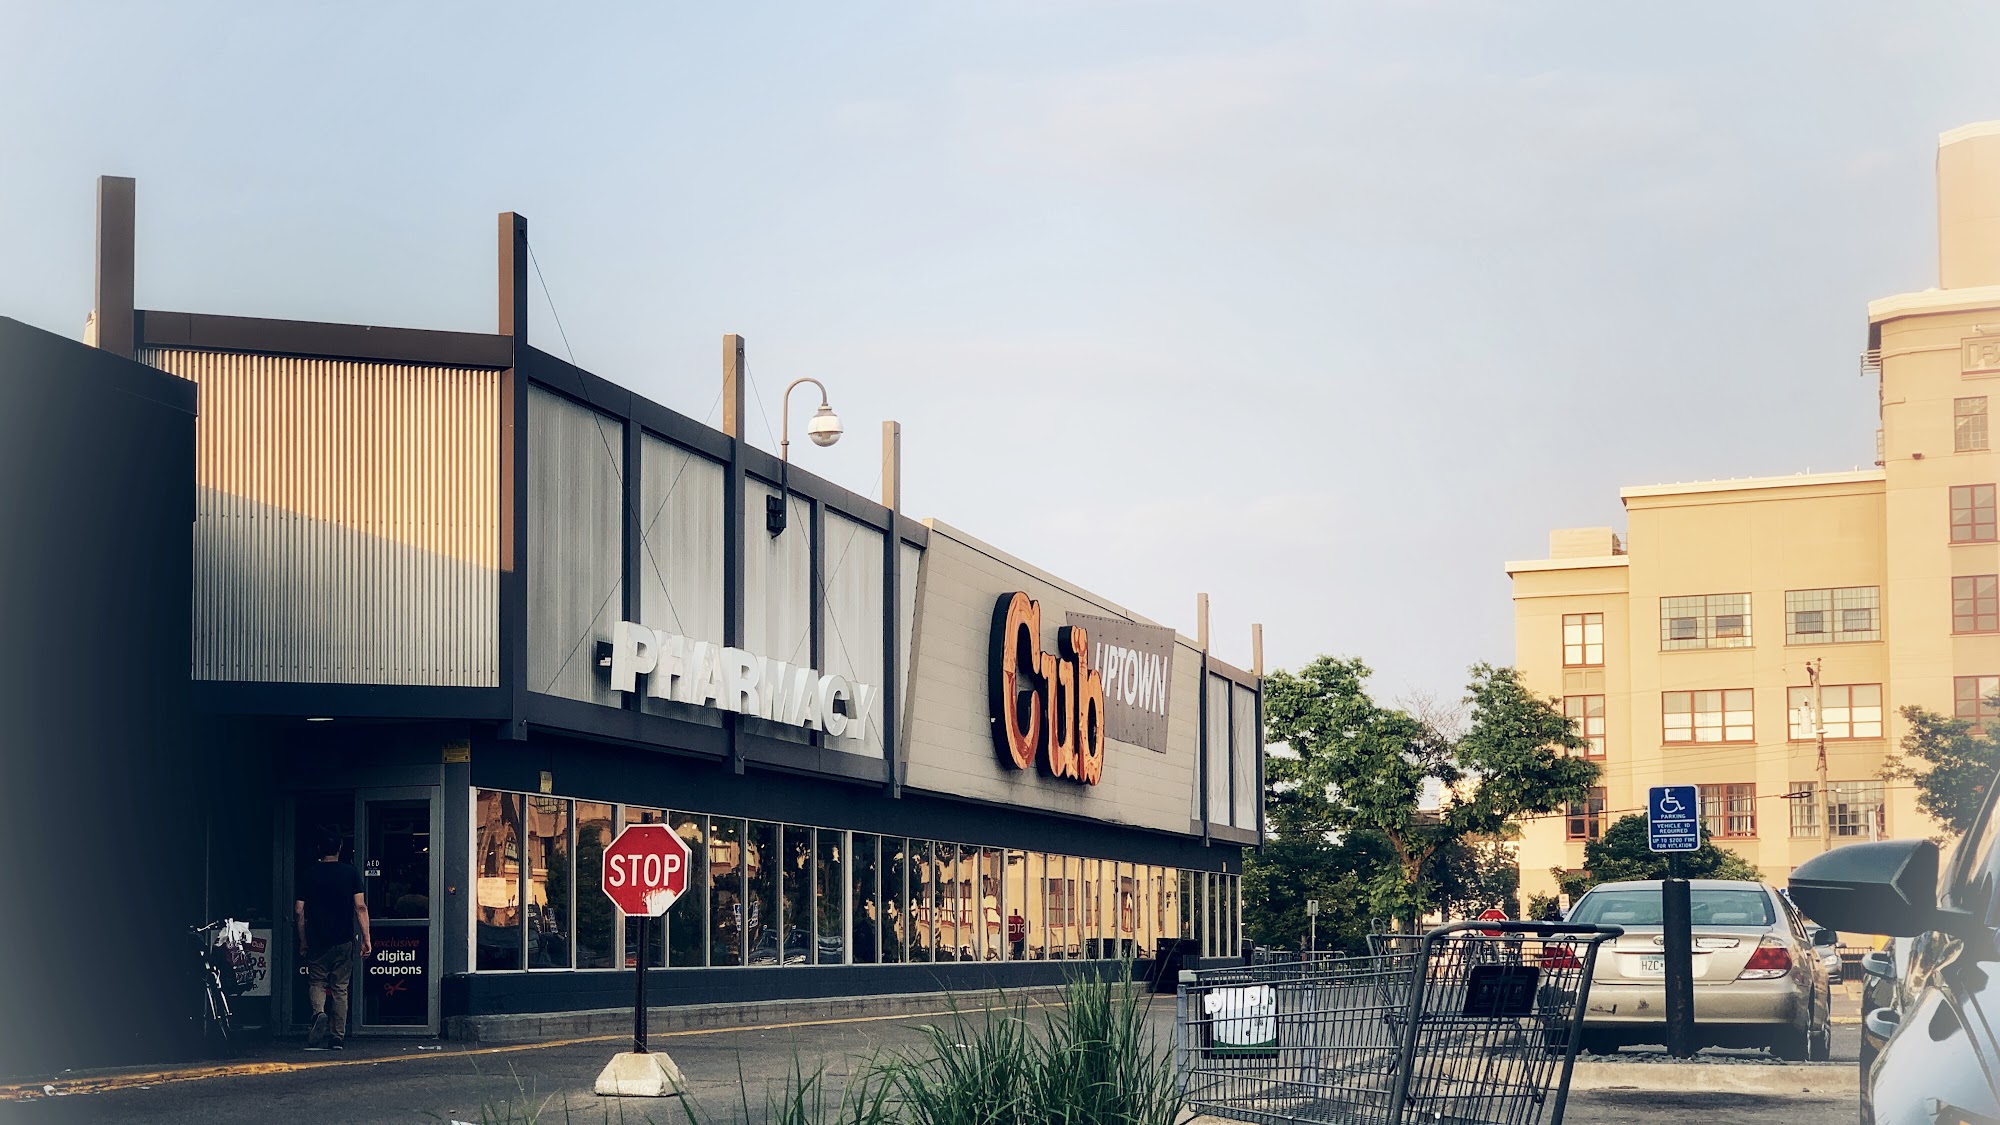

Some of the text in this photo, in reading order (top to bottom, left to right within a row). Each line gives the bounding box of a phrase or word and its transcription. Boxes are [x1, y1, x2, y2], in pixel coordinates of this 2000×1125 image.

[611, 621, 877, 740] PHARMACY
[990, 591, 1105, 786] Cub
[1095, 642, 1167, 715] UPTOWN
[609, 854, 681, 887] STOP
[374, 938, 420, 948] exclusive
[377, 950, 416, 963] digital
[370, 966, 422, 977] coupons
